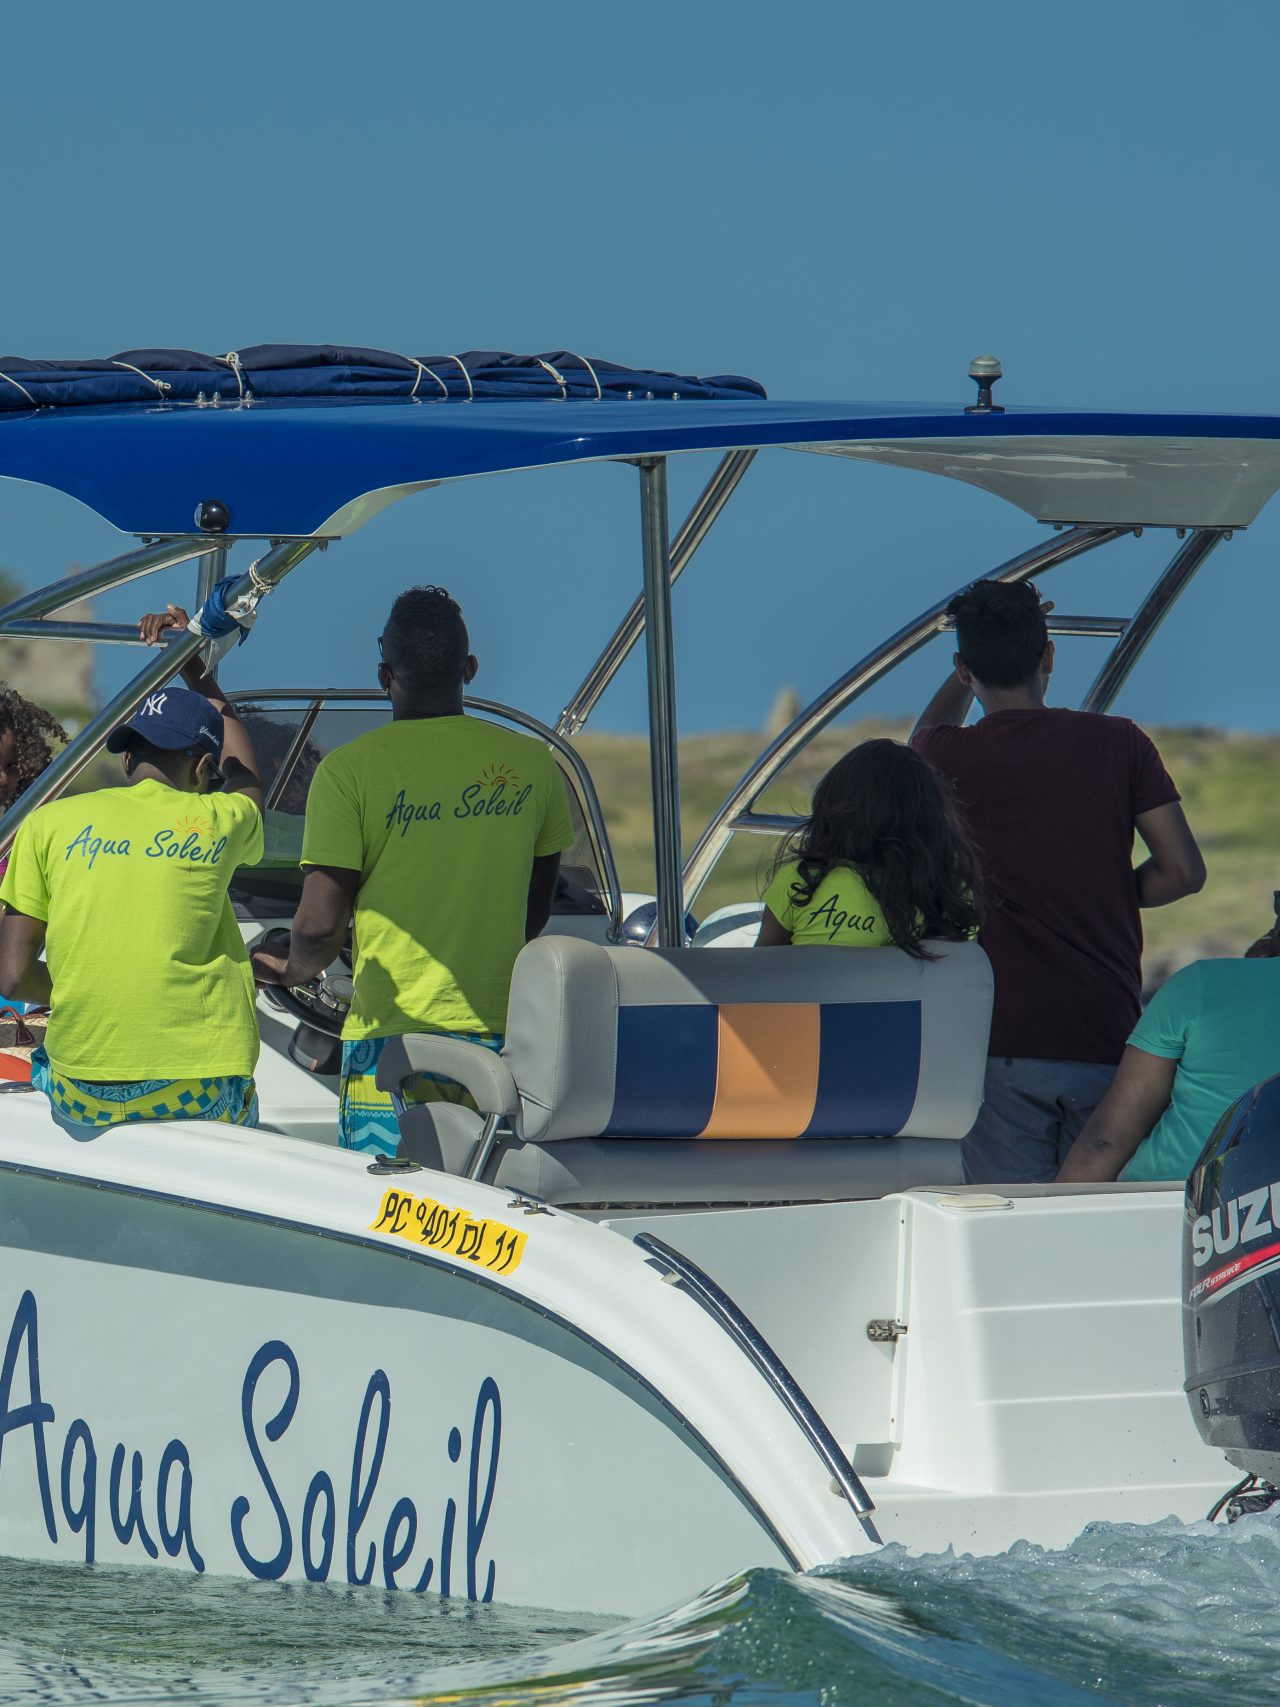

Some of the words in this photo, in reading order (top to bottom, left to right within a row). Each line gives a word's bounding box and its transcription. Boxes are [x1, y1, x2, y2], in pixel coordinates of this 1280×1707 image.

[140, 693, 168, 715] NY
[386, 789, 441, 837] Aqua
[454, 784, 532, 818] Soleil
[65, 824, 130, 870] Aqua
[145, 829, 228, 865] Soleil
[807, 893, 875, 941] Aqua
[375, 1192, 412, 1233] PC
[416, 1202, 460, 1249] 9401
[456, 1222, 487, 1261] DL
[486, 1230, 518, 1271] 11
[230, 1339, 502, 1603] Soleil
